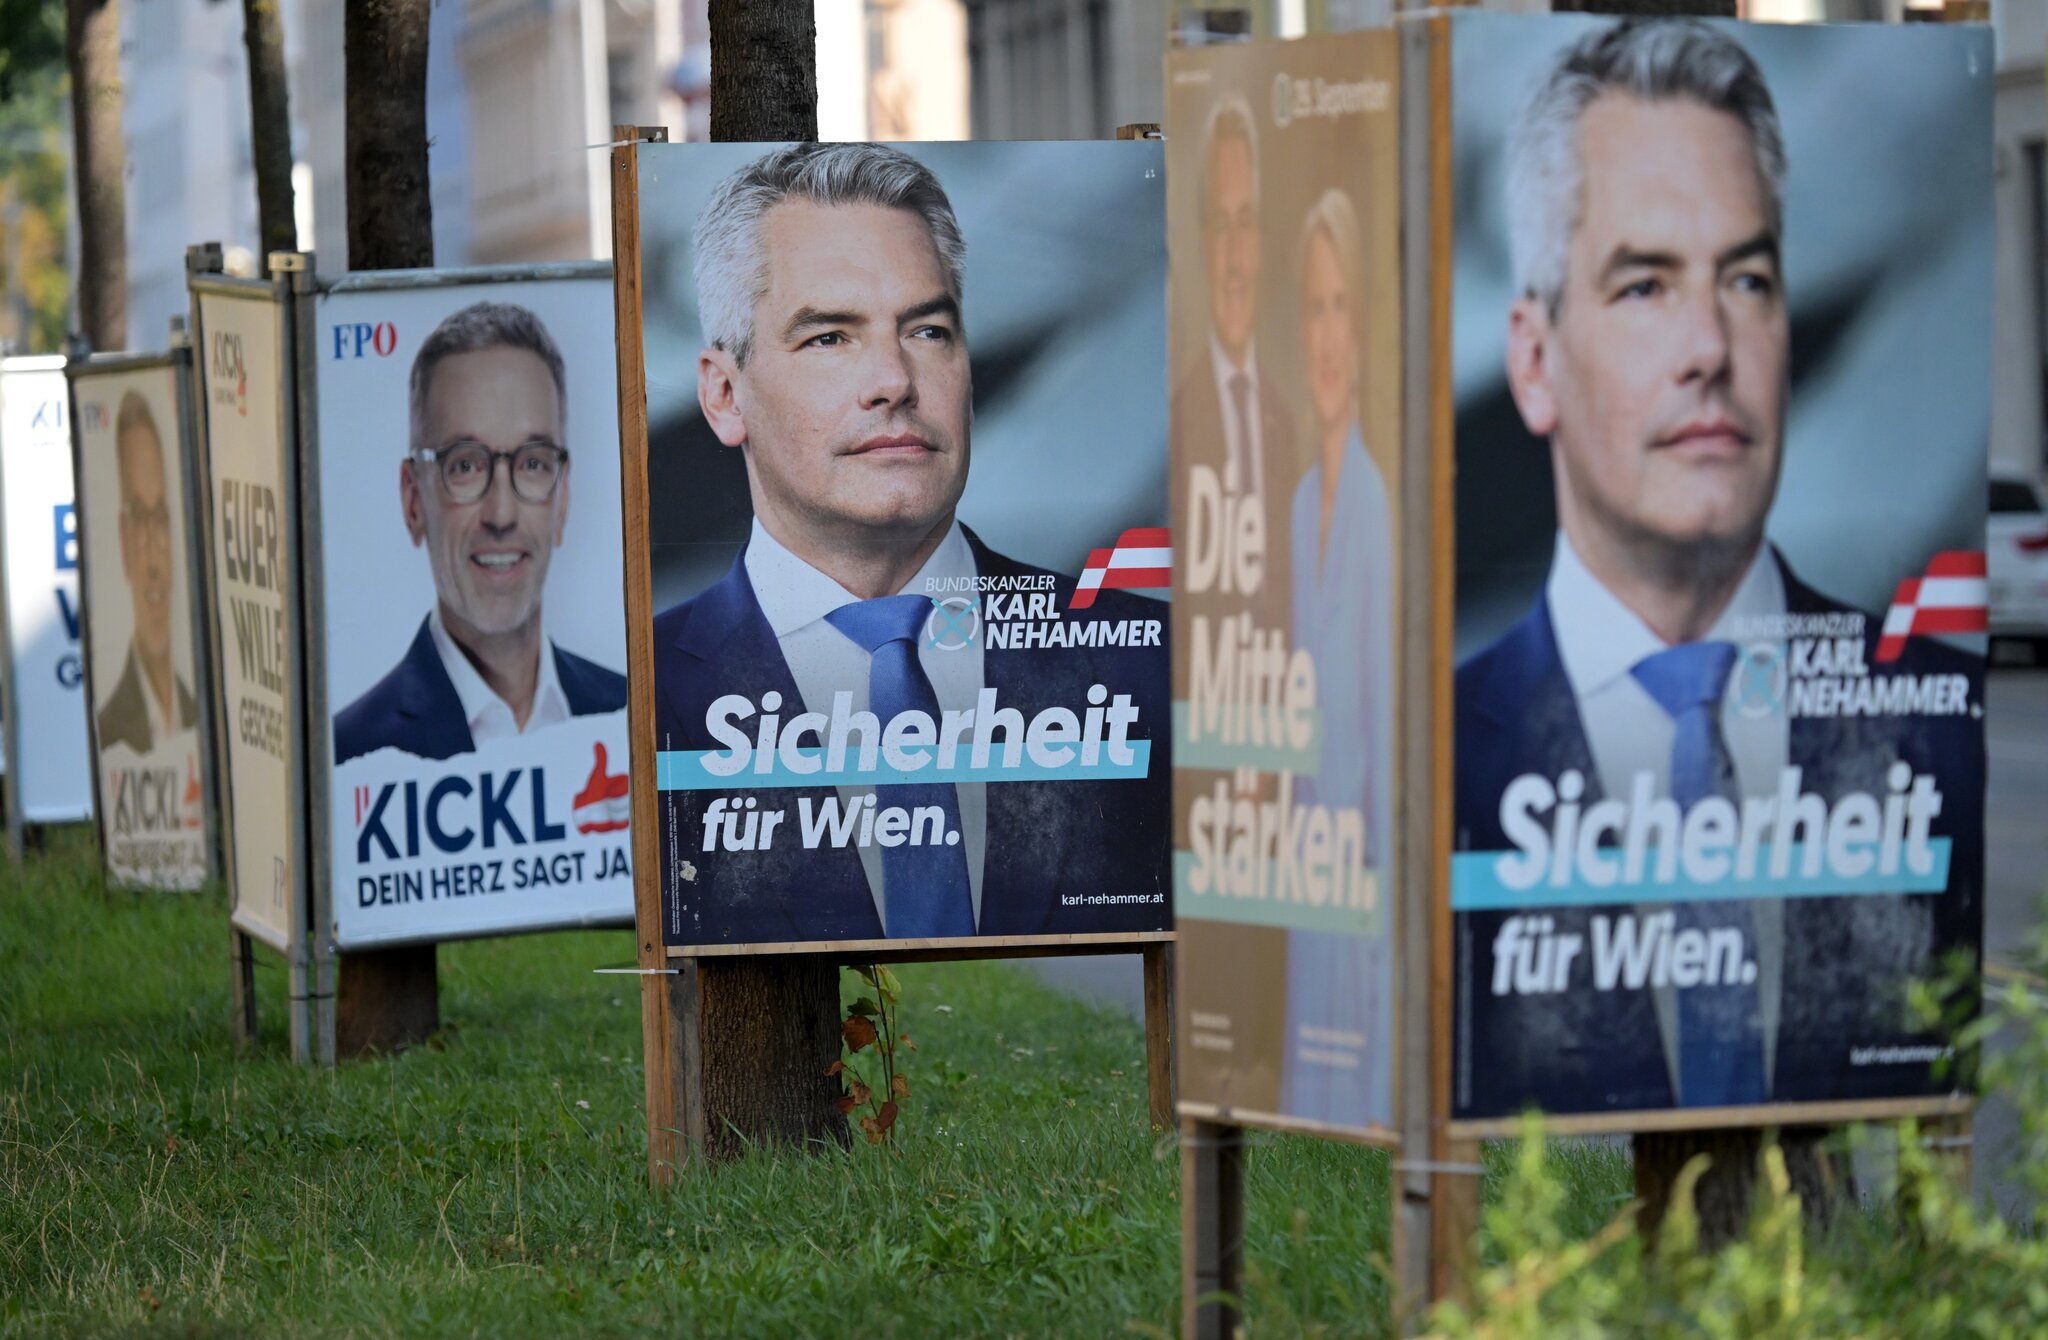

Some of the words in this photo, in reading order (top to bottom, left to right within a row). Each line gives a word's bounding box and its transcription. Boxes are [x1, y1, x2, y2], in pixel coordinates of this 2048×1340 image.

[221, 478, 280, 592] EUER
[1185, 464, 1266, 596] Die
[925, 575, 1056, 592] BUNDESKANZLER
[985, 593, 1061, 621] KARL
[229, 596, 282, 695] WILLE
[985, 620, 1162, 650] NEHAMMER
[1789, 638, 1868, 677] KARL
[1187, 611, 1318, 749] Mitte
[1789, 673, 1970, 719] NEHAMMER
[699, 684, 1140, 777] Sicherheit
[110, 767, 181, 834] KICKL
[355, 765, 566, 864] KICKL
[701, 797, 785, 852] für
[798, 794, 960, 850] Wien.
[1493, 760, 1943, 890] Sicherheit
[1187, 765, 1377, 913] stärken.
[358, 870, 424, 908] DEIN
[431, 861, 505, 900] HERZ
[512, 851, 586, 890] SAGT
[594, 847, 630, 880] JA
[1061, 893, 1164, 906] karl-nehammer.at
[1491, 916, 1583, 996] für
[1589, 910, 1758, 991] Wien.
